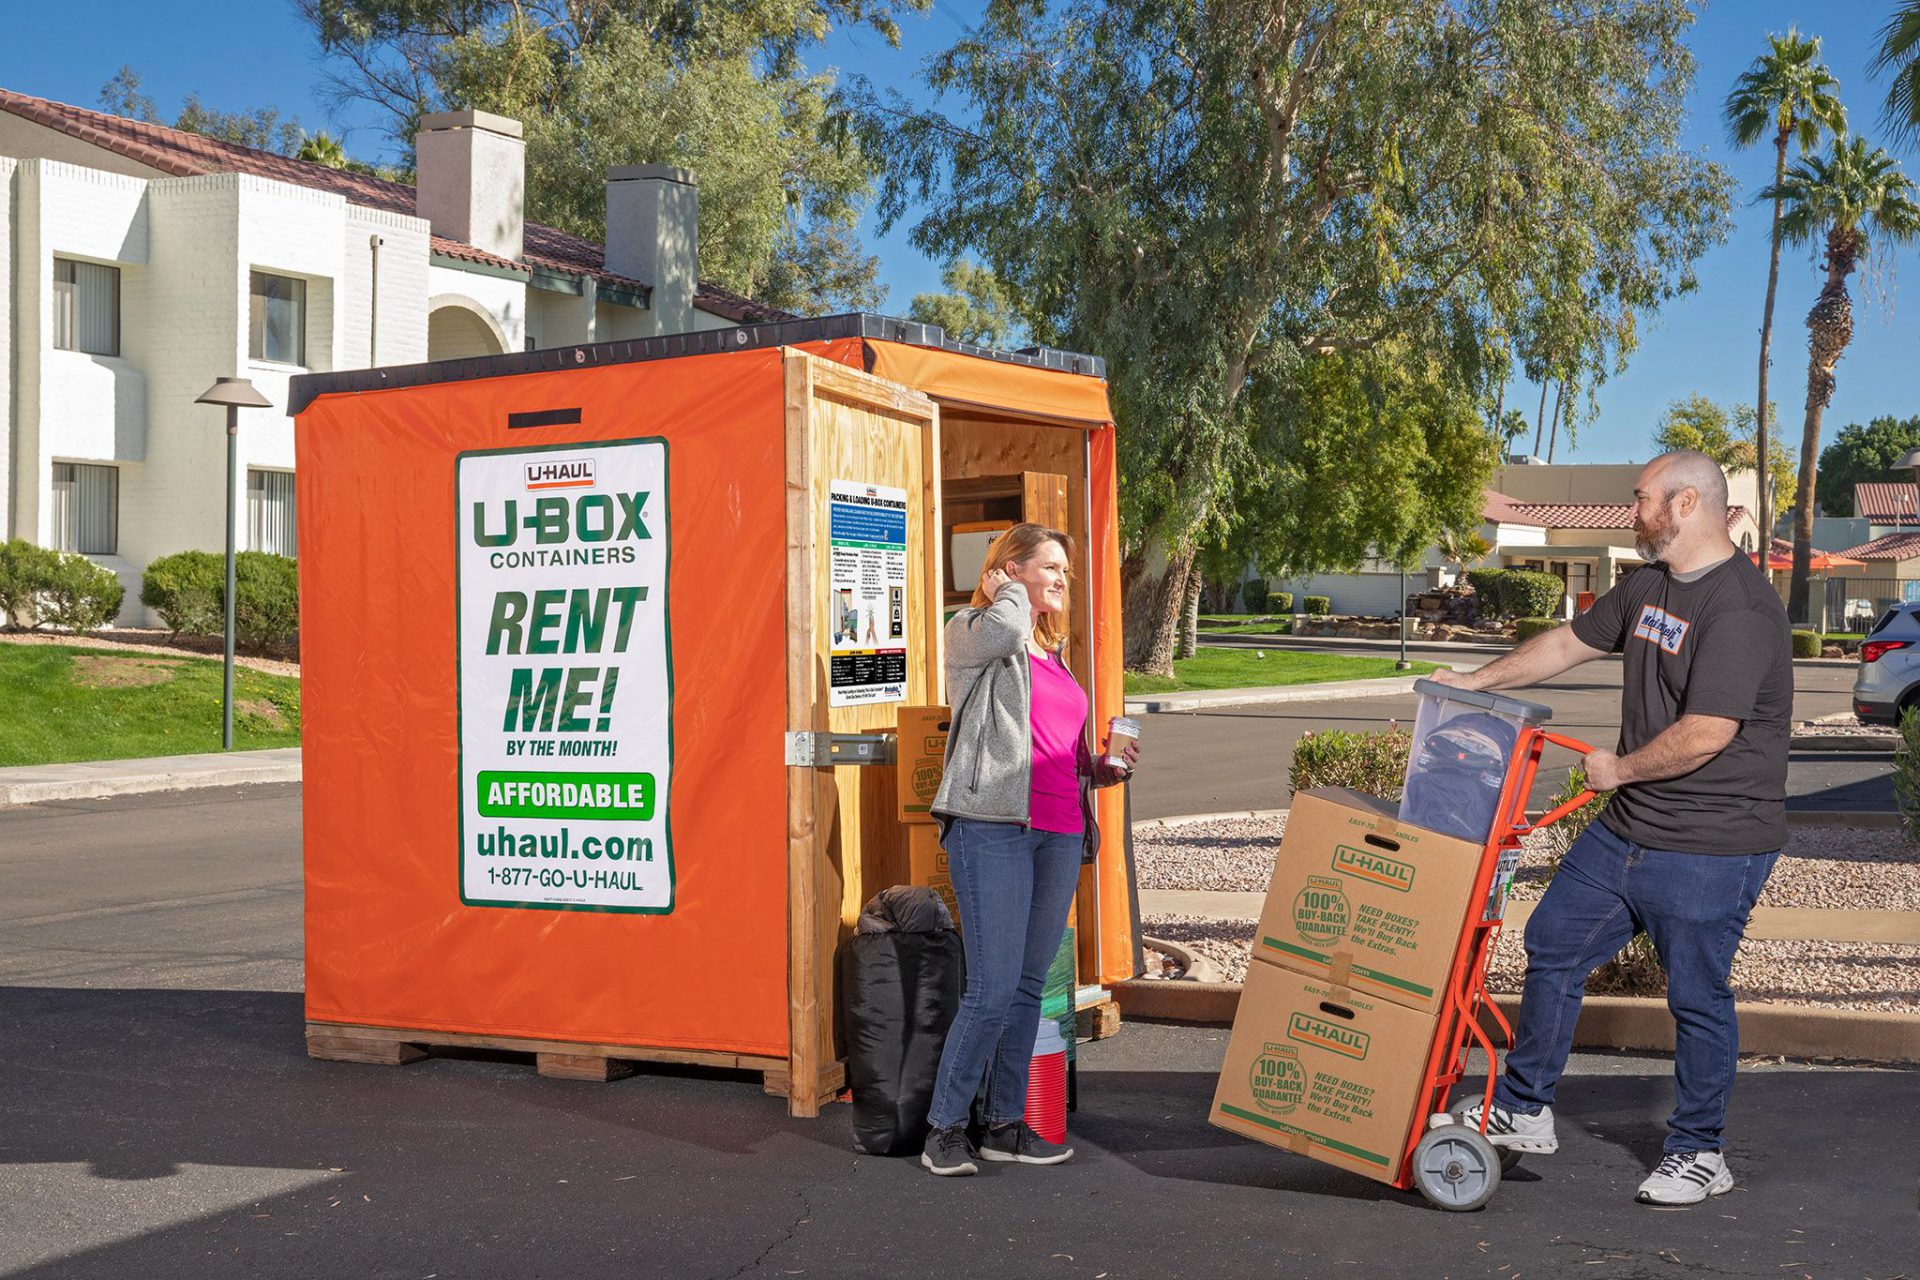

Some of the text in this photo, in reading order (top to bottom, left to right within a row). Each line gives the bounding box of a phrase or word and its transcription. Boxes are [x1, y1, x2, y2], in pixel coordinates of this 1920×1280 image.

[528, 462, 592, 481] U-HAUL
[853, 495, 870, 505] LOADING
[884, 499, 906, 510] CONTAINERS
[473, 491, 653, 548] U-BOX
[490, 546, 636, 569] CONTAINERS
[486, 586, 649, 656] RENT
[503, 667, 620, 733] ME!
[506, 740, 618, 757] BY THE MONTH!
[487, 782, 645, 809] AFFORDABLE
[477, 826, 654, 862] uhaul.com
[1394, 831, 1419, 842] ANDLES
[1340, 850, 1408, 881] U-HAUL
[488, 867, 644, 891] 1-877-GO-U-HAUL
[1303, 891, 1344, 912] 100%
[1298, 908, 1346, 924] BUY-BACK
[1356, 913, 1415, 938] TAKE PLENTY!
[1359, 904, 1419, 928] NEED BOXES?
[1295, 921, 1346, 936] GUARANTEE
[1353, 923, 1418, 950] We'll Buy Back
[1351, 934, 1365, 945] the
[1367, 940, 1396, 955] Extras.
[1295, 1017, 1363, 1049] U-HAUL
[1259, 1059, 1300, 1080] 100%
[1252, 1087, 1303, 1104] GUARANTEE
[1255, 1075, 1303, 1092] BUY-BACK
[1312, 1081, 1371, 1107] TAKE PLENTY!
[1315, 1072, 1376, 1097] NEED BOXES?
[1307, 1102, 1321, 1113] the
[1323, 1107, 1352, 1124] Extras.
[1310, 1091, 1374, 1118] We'll Buy Back
